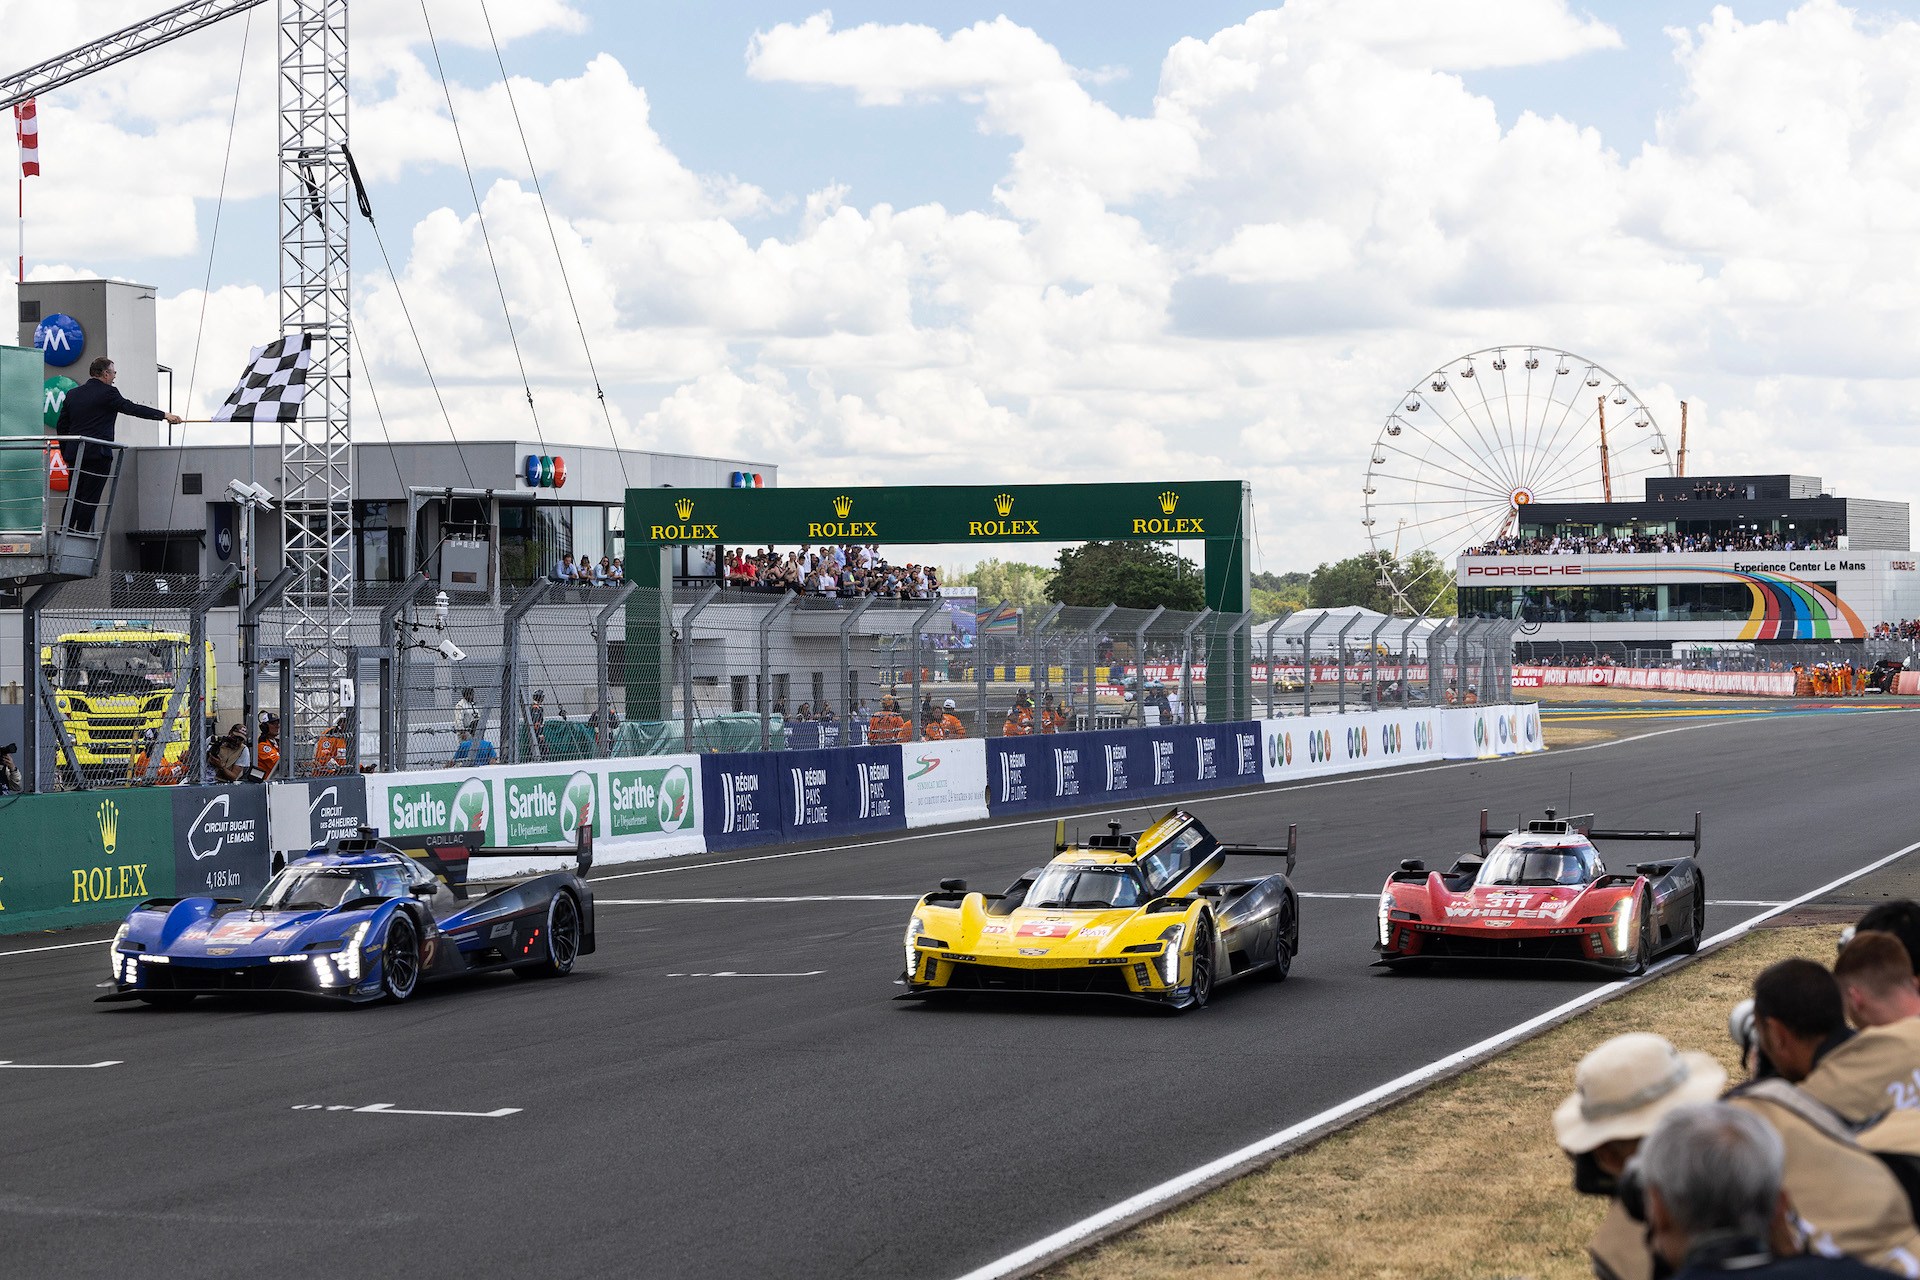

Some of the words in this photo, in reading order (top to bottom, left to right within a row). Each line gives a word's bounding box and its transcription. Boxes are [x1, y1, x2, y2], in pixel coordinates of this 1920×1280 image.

[651, 524, 719, 540] ROLEX
[808, 521, 878, 537] ROLEX
[969, 520, 1040, 536] ROLEX
[1132, 518, 1205, 533] ROLEX
[1468, 565, 1582, 576] PORSCHE
[1734, 562, 1786, 573] Experience
[1789, 561, 1821, 572] Center
[1824, 561, 1836, 571] Le
[1839, 561, 1866, 571] Mans
[1510, 678, 1539, 687] OTUL
[805, 767, 826, 786] RÉGION
[869, 763, 890, 781] RÉGION
[735, 772, 758, 792] RÉGION
[613, 777, 654, 811] Sarthe
[805, 788, 821, 805] PAYS
[870, 783, 885, 799] PAYS
[509, 784, 556, 819] Sarthe
[736, 794, 753, 811] PAYS
[876, 800, 890, 816] LOIRE
[320, 806, 343, 817] CIRCUIT
[393, 791, 446, 829] Sarthe
[811, 806, 828, 823] LOIRE
[204, 822, 229, 833] CIRCUIT
[229, 819, 255, 831] BUGATTI
[336, 817, 358, 827] HEURES
[742, 813, 760, 831] LOIRE
[227, 834, 233, 843] LE
[233, 832, 255, 843] MANS
[331, 830, 339, 839] DU
[339, 828, 358, 838] MANS
[511, 824, 518, 837] Le
[519, 822, 548, 839] Département
[426, 834, 464, 846] CADILLAC
[72, 863, 148, 903] ROLEX
[206, 870, 226, 889] 4,185
[228, 869, 240, 886] km
[1484, 898, 1528, 908] 311
[1444, 906, 1564, 919] WHELEN
[224, 926, 252, 938] 2
[982, 926, 1006, 934] HY
[1032, 925, 1056, 937] 3
[423, 940, 436, 969] 2
